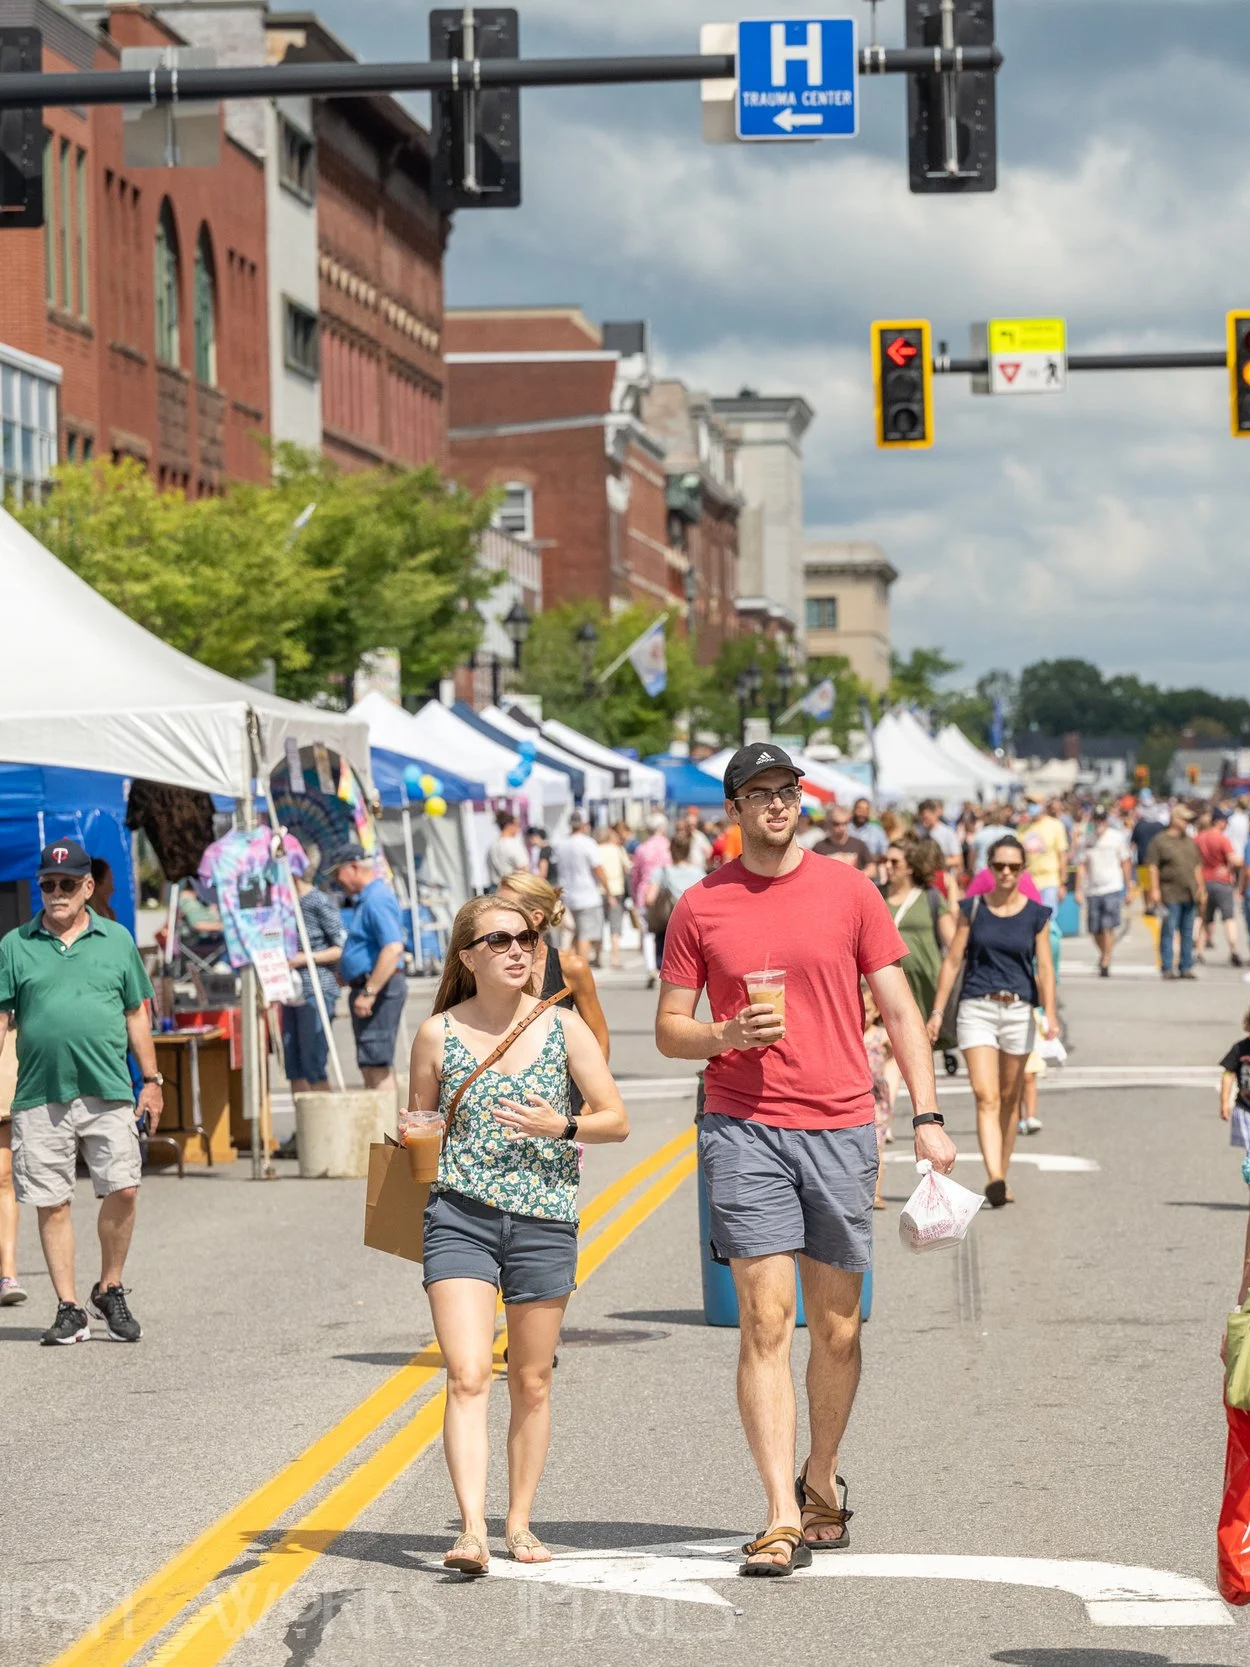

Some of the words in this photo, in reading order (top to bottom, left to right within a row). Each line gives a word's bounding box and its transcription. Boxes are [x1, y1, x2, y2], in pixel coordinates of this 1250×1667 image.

[770, 22, 823, 87] H
[743, 91, 797, 107] TRAUMA
[801, 90, 852, 106] CENTER
